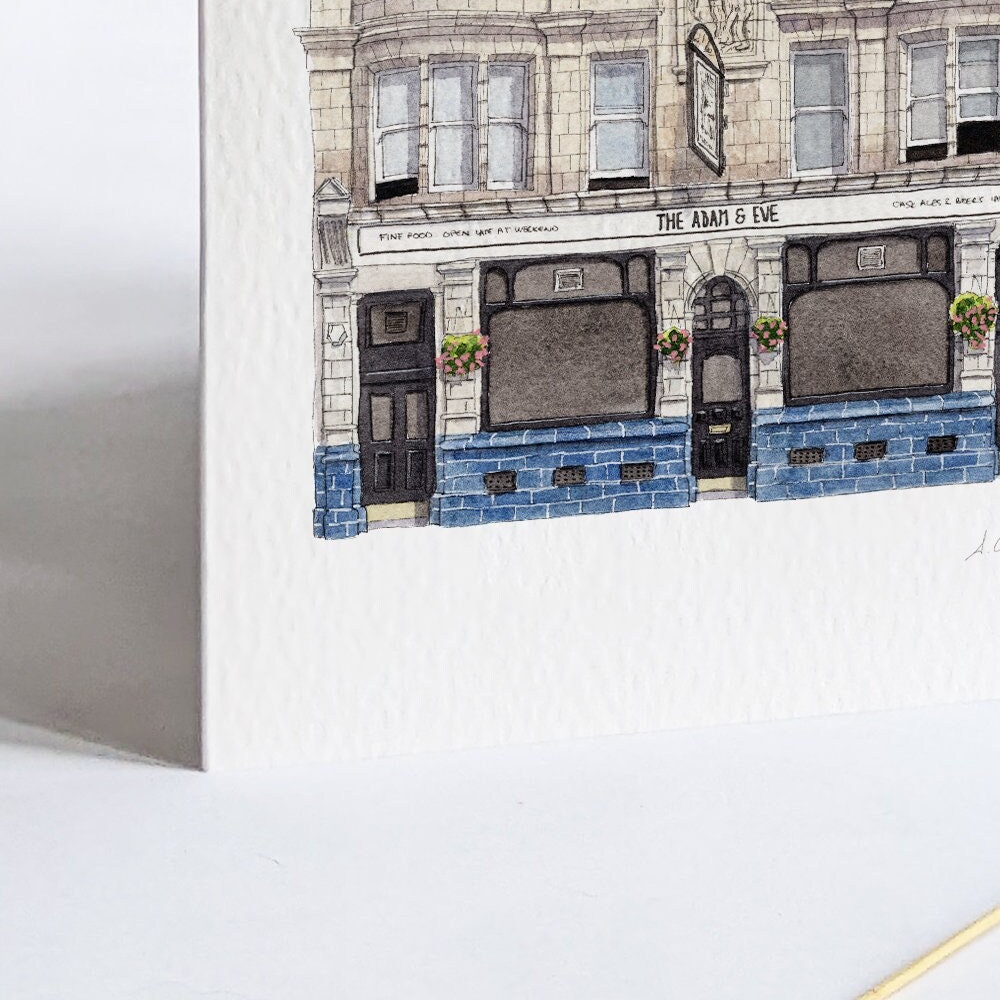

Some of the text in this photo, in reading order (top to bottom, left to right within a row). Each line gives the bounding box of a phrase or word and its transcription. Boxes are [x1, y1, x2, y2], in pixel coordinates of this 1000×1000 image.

[656, 203, 780, 231] THE ADAM & EVE
[442, 229, 470, 238] OPEN
[497, 226, 511, 235] AT
